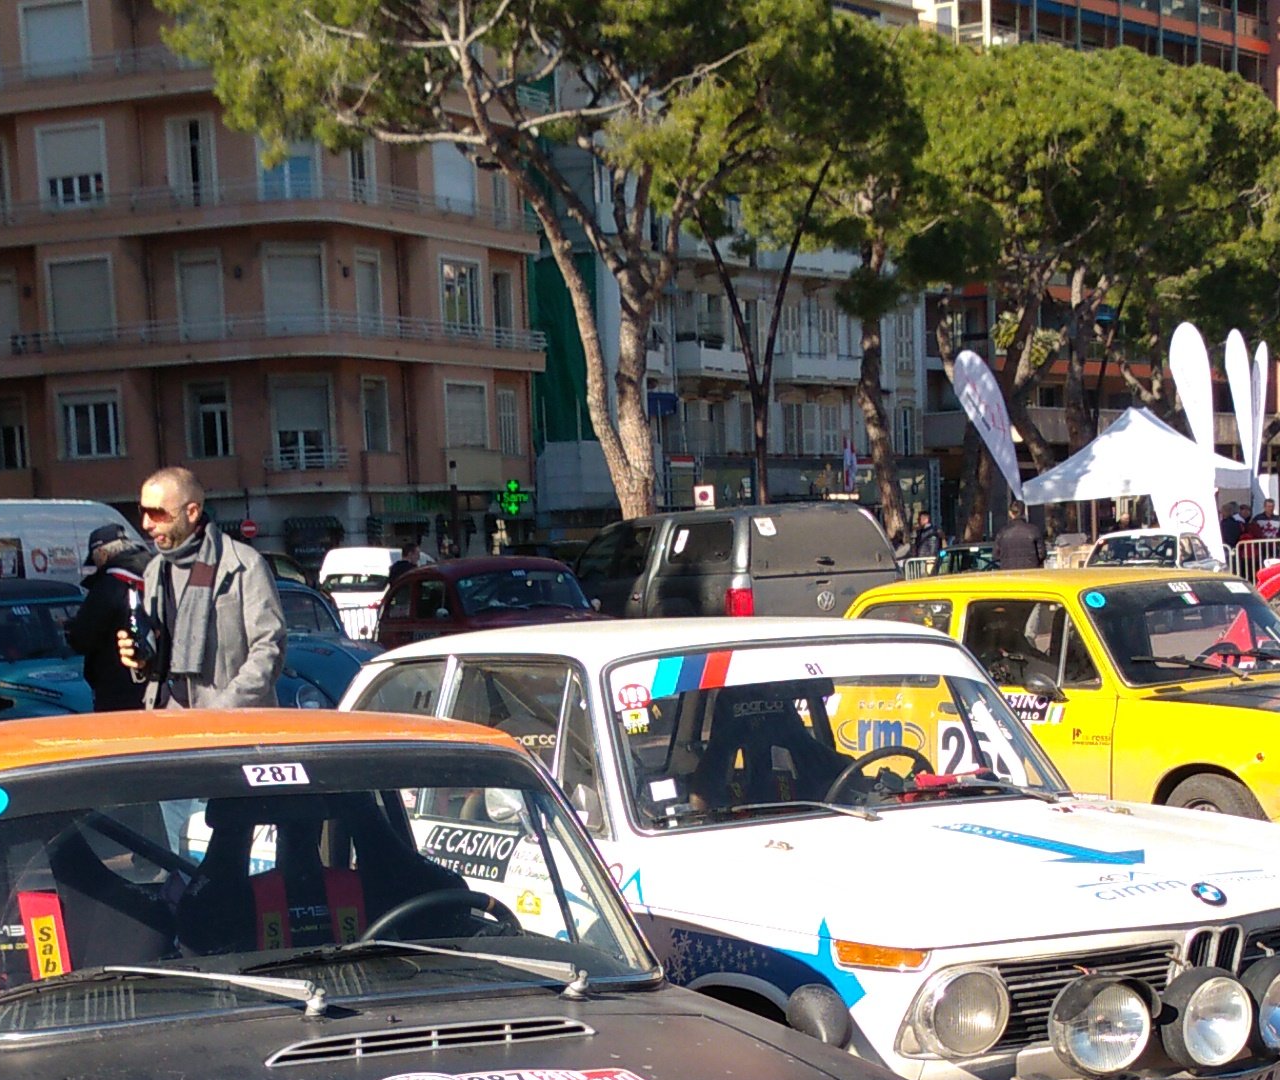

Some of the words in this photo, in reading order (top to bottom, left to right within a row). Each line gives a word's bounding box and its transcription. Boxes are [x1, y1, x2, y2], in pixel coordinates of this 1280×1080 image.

[252, 766, 299, 783] 287
[426, 827, 446, 850] LE
[446, 829, 515, 860] CASINO
